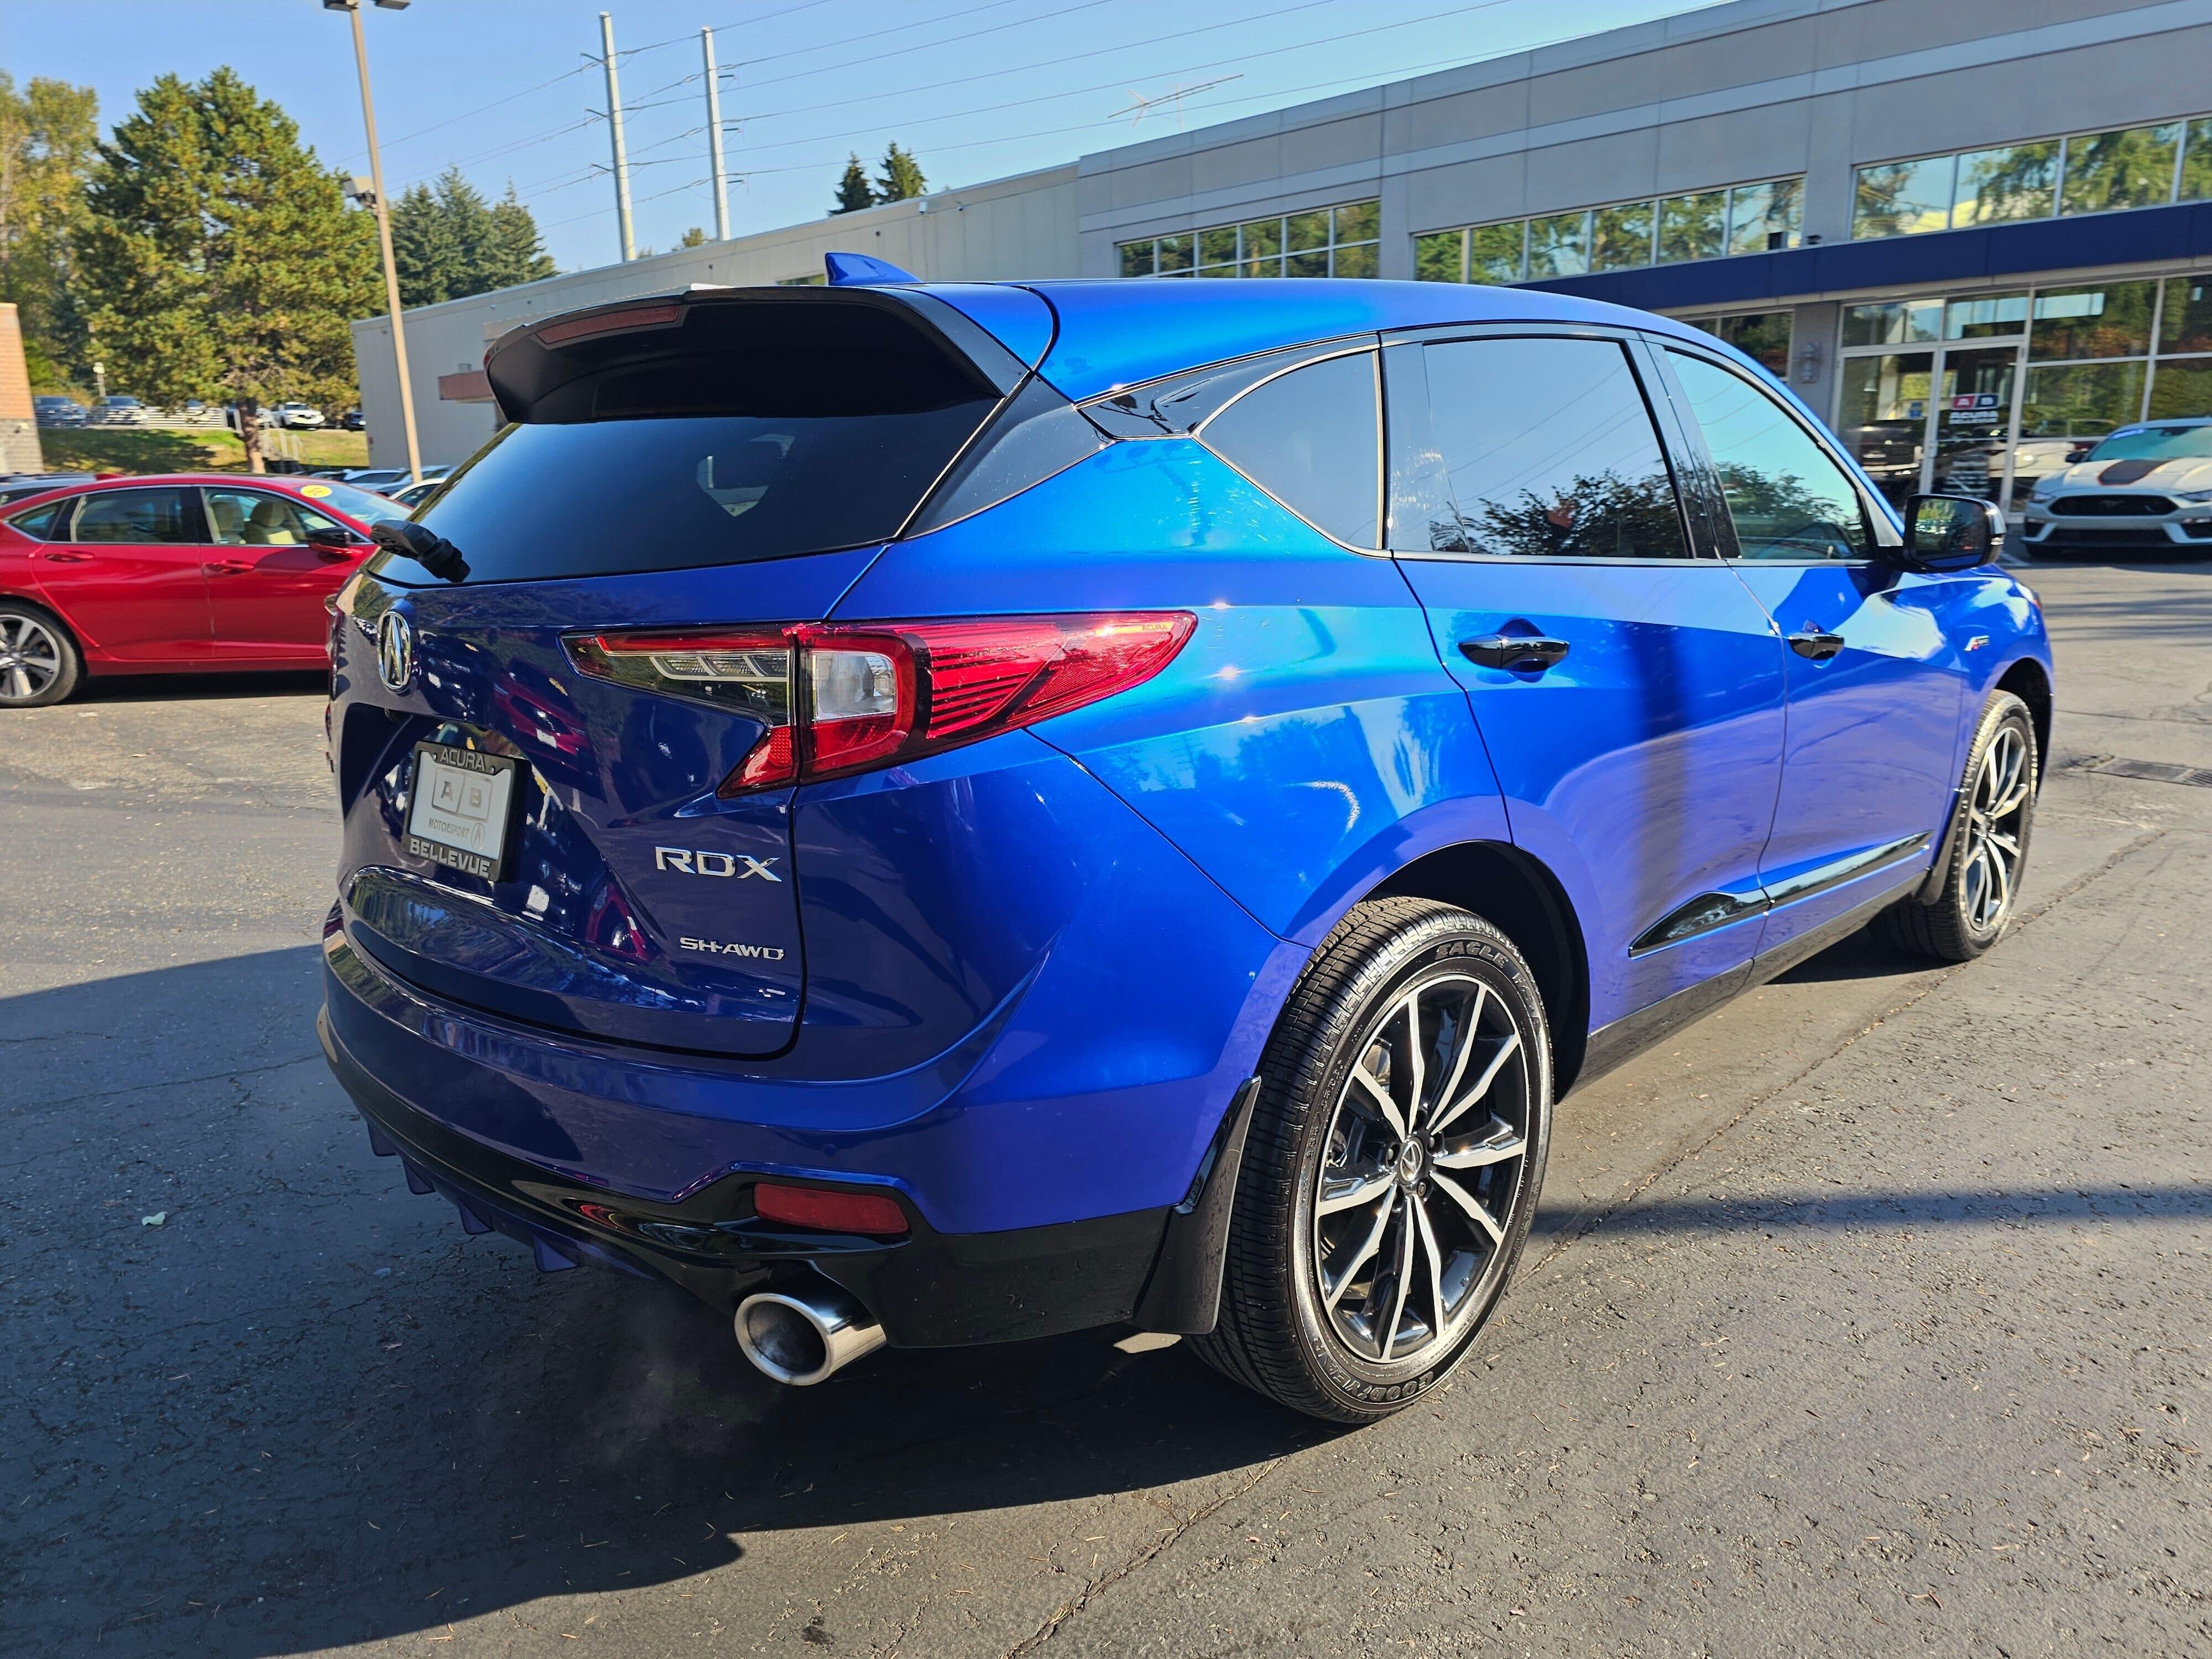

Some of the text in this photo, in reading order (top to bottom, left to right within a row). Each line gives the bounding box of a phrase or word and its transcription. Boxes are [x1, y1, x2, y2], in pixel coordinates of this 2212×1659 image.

[440, 747, 486, 772] ACURA
[441, 781, 483, 809] A B
[427, 817, 470, 839] MOTORSPORT
[409, 838, 491, 878] BELLEVUE
[655, 846, 782, 883] RDX
[679, 937, 785, 961] SH-AWD
[1434, 941, 1509, 968] EAGLE
[1312, 1336, 1434, 1402] GOODYEAR
